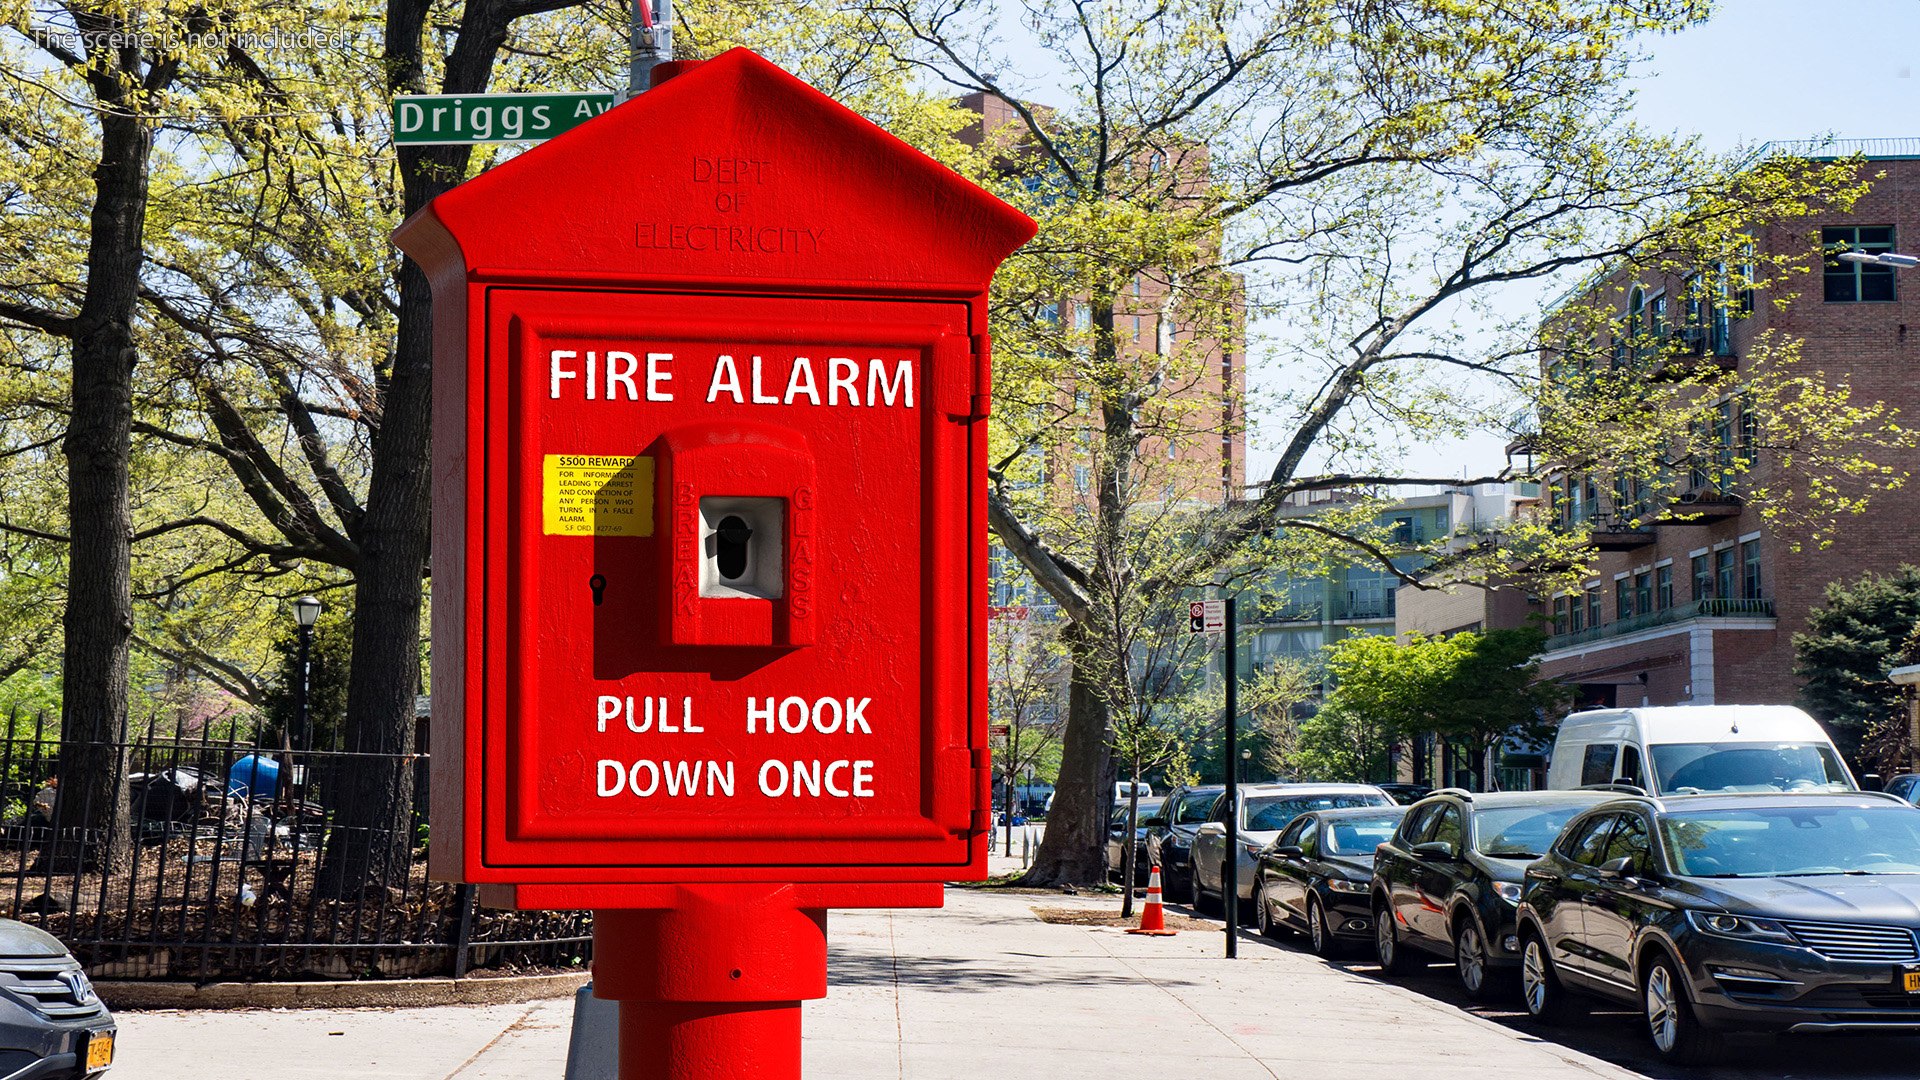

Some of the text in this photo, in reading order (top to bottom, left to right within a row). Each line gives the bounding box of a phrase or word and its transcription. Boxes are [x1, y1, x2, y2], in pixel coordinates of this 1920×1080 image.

[400, 99, 551, 139] Driggs
[693, 156, 771, 184] DEPT
[715, 192, 746, 213] OF
[635, 223, 825, 254] ELECTRICITY
[550, 350, 914, 407] FIRE ALARM
[559, 456, 635, 467] $500 REWARD
[583, 471, 634, 479] INFORMATION
[674, 481, 697, 617] BREAK
[789, 485, 813, 620] GLASS
[597, 696, 872, 734] PULL HOOK
[596, 759, 874, 797] DOWN ONCE
